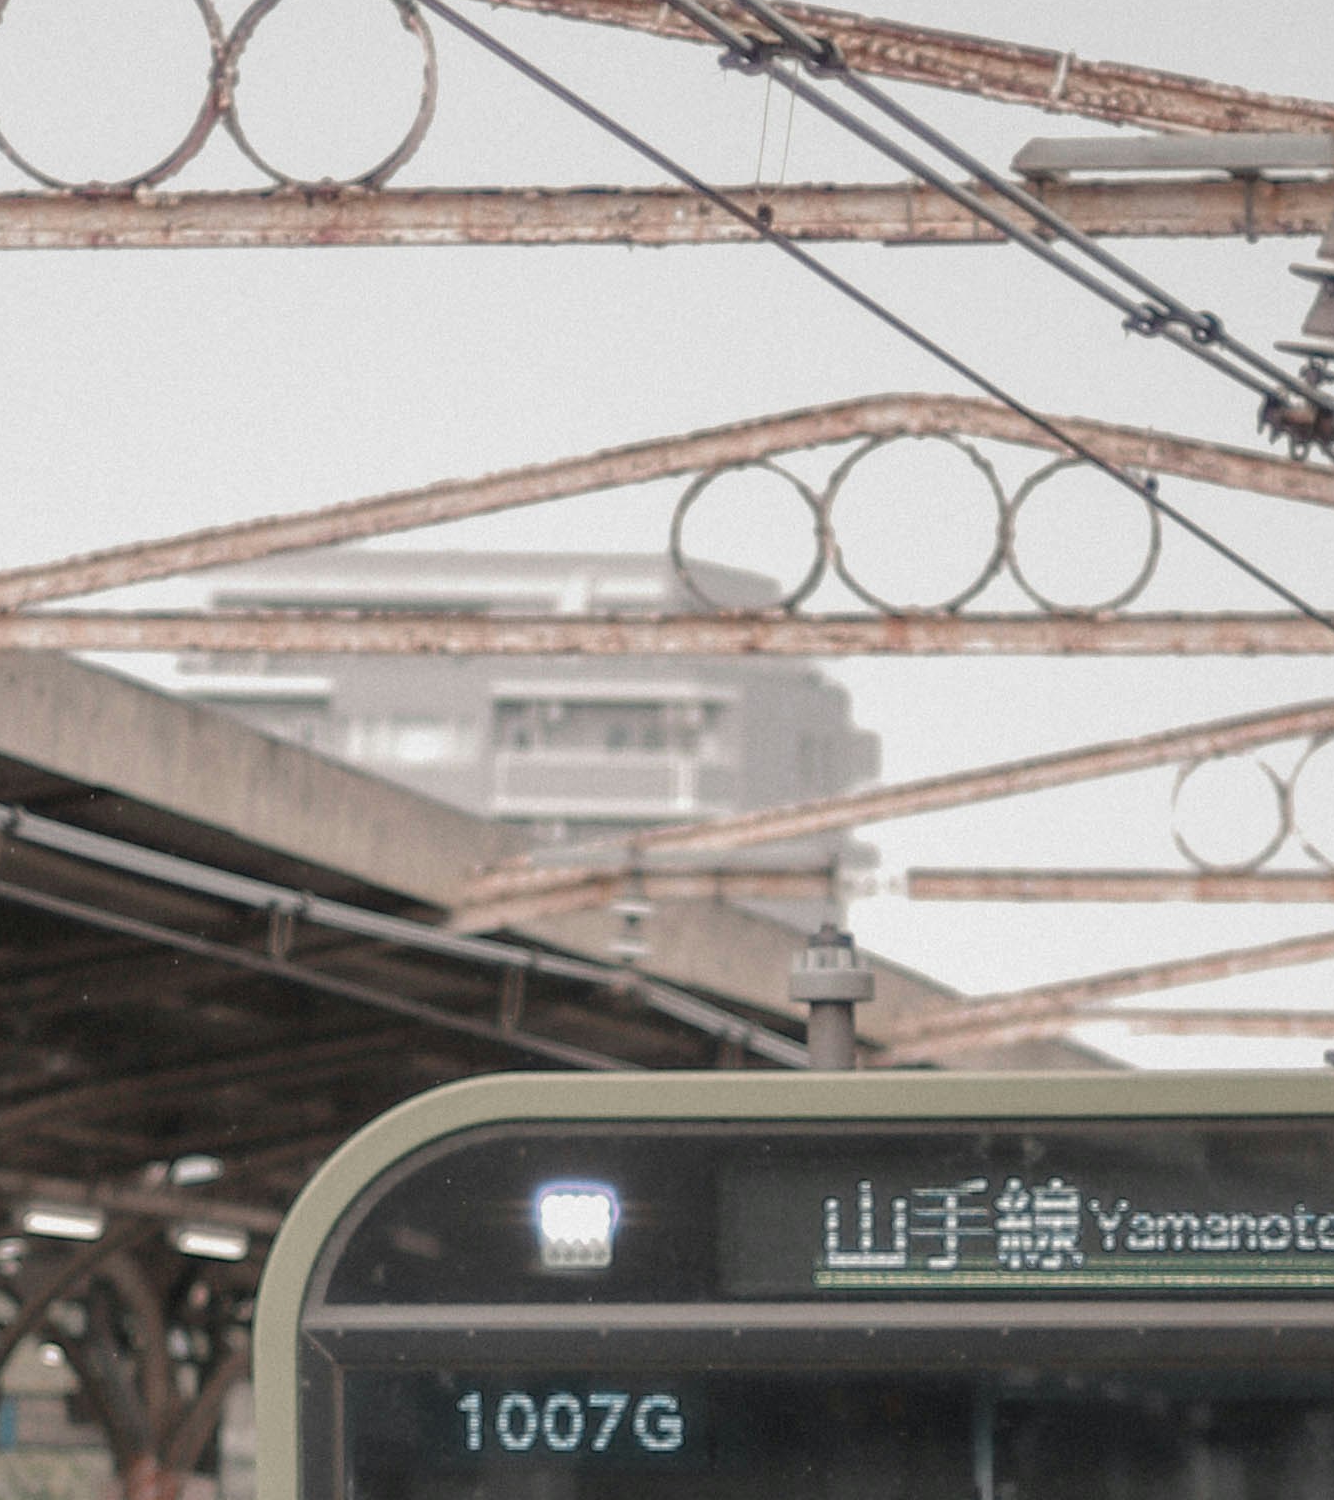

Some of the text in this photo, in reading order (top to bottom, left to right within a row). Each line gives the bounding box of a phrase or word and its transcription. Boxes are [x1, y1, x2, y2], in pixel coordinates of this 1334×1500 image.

[824, 1178, 1086, 1270] 山手線
[456, 1391, 685, 1451] 1007G
